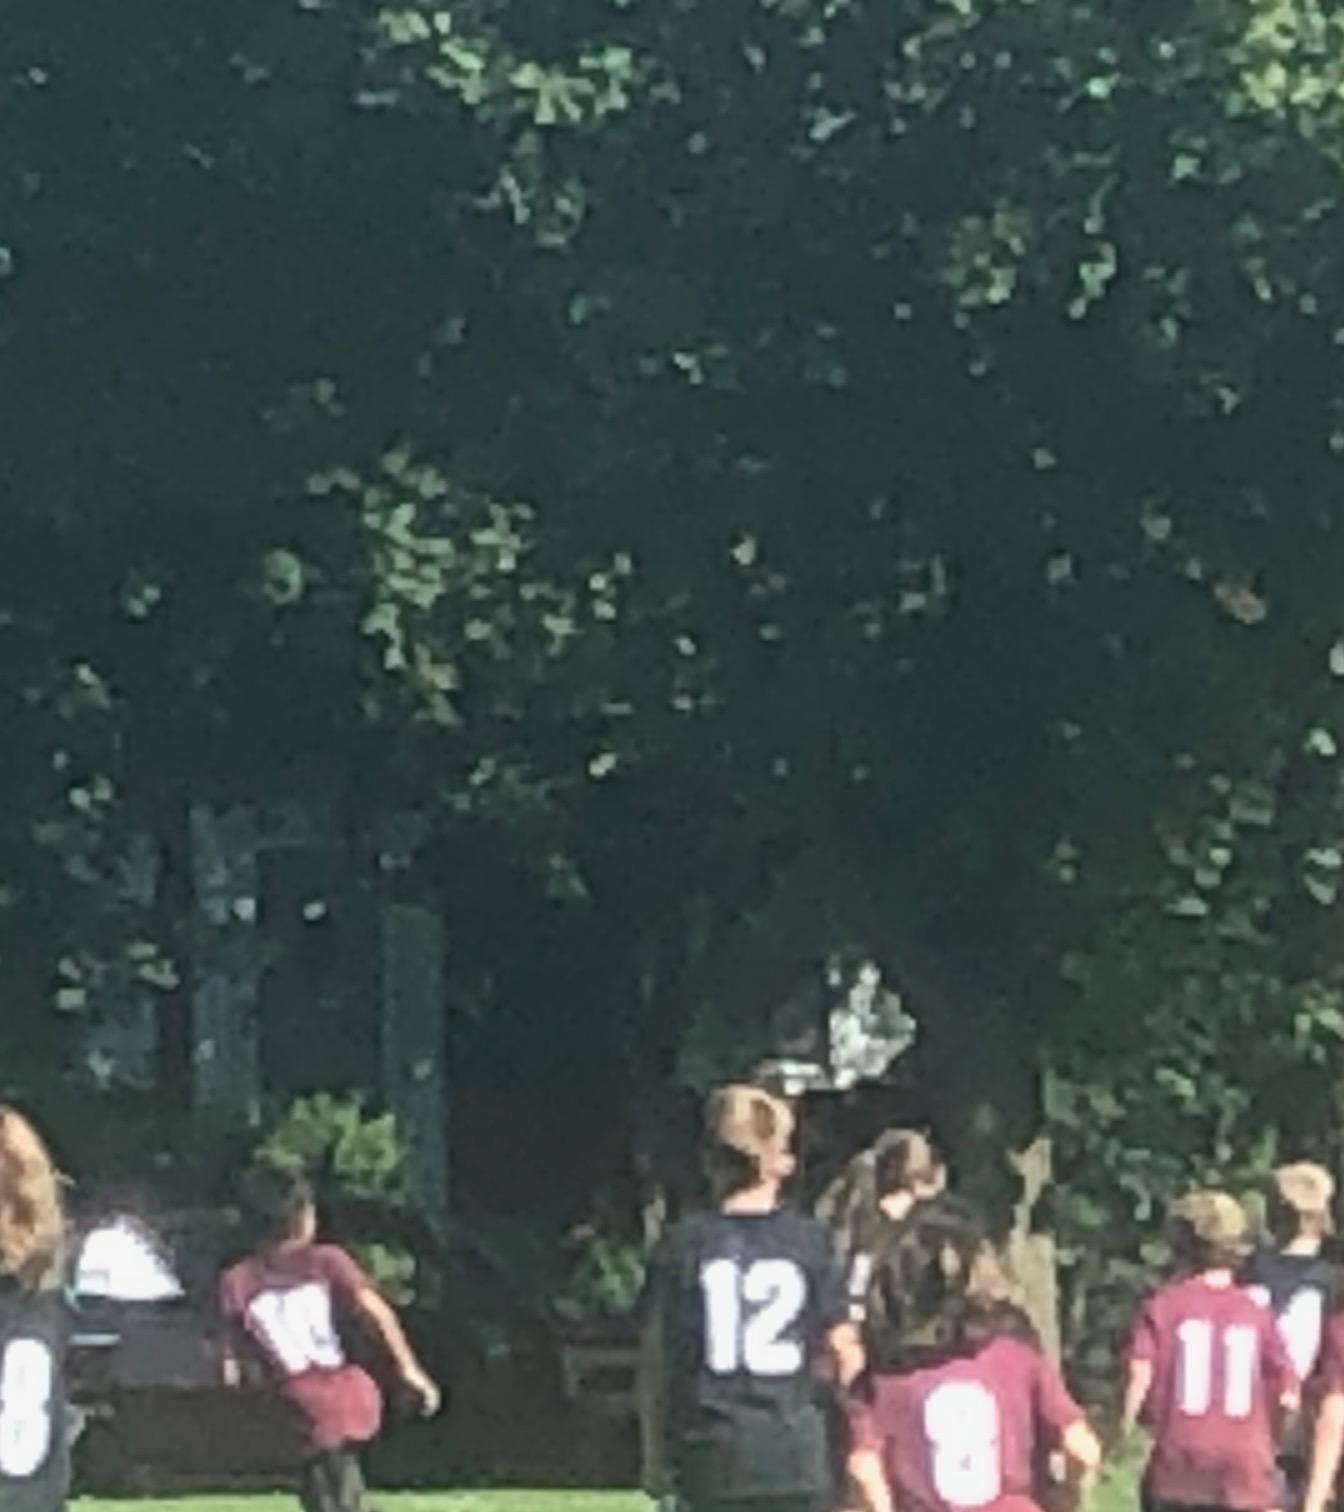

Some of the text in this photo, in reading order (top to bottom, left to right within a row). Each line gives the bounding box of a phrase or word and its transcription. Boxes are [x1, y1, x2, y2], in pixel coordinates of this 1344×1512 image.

[700, 1257, 806, 1374] 12
[1177, 1318, 1257, 1418] 11
[924, 1381, 1000, 1505] 8
